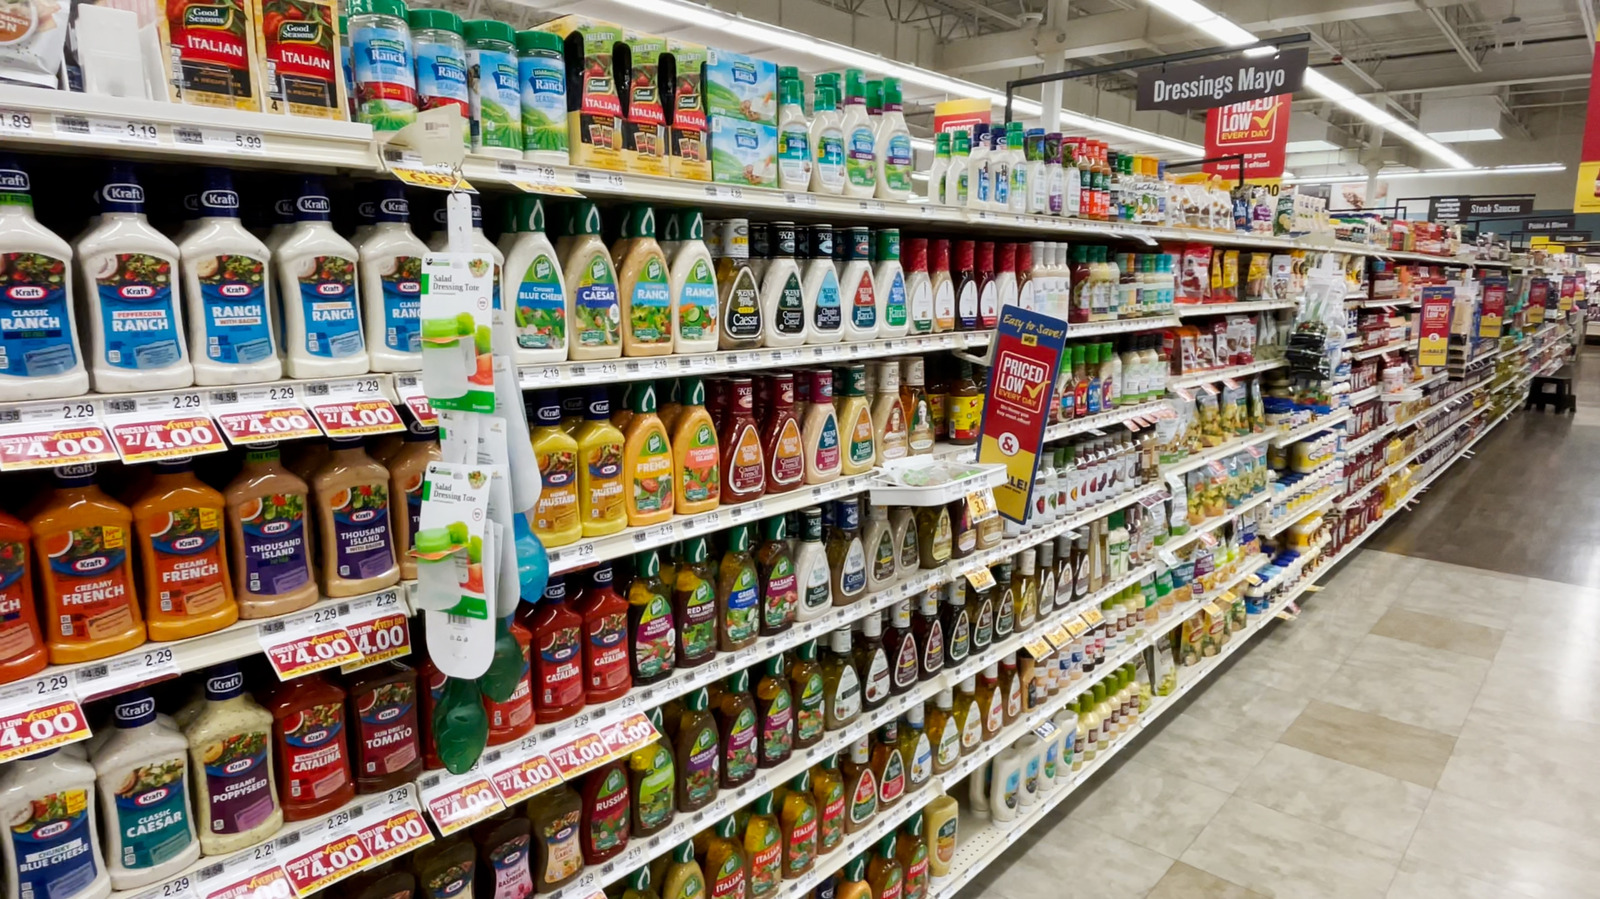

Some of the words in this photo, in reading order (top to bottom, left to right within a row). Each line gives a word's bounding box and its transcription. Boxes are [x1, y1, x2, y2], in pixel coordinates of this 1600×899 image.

[188, 14, 224, 24] Seasons
[193, 8, 218, 17] Good
[282, 30, 315, 39] Seasons
[286, 24, 309, 33] Good
[187, 35, 243, 57] ITALIAN
[281, 50, 330, 70] ITALIAN
[371, 50, 406, 66] Ranch
[438, 66, 466, 82] Ranch
[536, 79, 565, 93] Ranch
[1153, 75, 1233, 102] Dressings
[1238, 67, 1285, 93] Mayo
[585, 97, 620, 113] ITALIAN
[630, 107, 663, 122] ITALIAN
[1221, 113, 1252, 132] LOW
[127, 124, 157, 139] 3.19
[1221, 131, 1250, 140] EVERY
[1251, 129, 1269, 138] DAY
[235, 135, 261, 148] 5.99
[112, 187, 141, 200] Kraft
[209, 193, 236, 206] Kraft
[304, 199, 328, 210] Kraft
[1470, 204, 1492, 213] Steak
[433, 274, 452, 283] Salad
[15, 287, 40, 297] Kraft
[126, 286, 148, 297] Kraft
[225, 285, 246, 295] Kraft
[322, 284, 340, 293] Kraft
[432, 282, 463, 293] Dressing
[465, 284, 480, 292] Tote
[685, 286, 714, 298] RANCH
[519, 291, 539, 300] BLUE
[582, 291, 615, 301] CAESAR
[637, 289, 669, 300] RANCH
[12, 309, 49, 317] CLASSIC
[212, 305, 261, 318] RANCH
[312, 309, 355, 321] RANCH
[1, 317, 60, 330] RANCH
[112, 318, 169, 332] RANCH
[733, 314, 758, 326] Caesar
[1002, 314, 1025, 333] Easy
[1025, 320, 1036, 330] to
[1036, 324, 1064, 339] Save!
[543, 369, 560, 378] 2.19
[1003, 357, 1044, 384] PRICED
[357, 380, 379, 393] 2.29
[1000, 373, 1025, 394] LOW
[269, 387, 295, 400] 2.29
[998, 388, 1021, 401] EVERY
[172, 395, 200, 409] 2.29
[62, 404, 94, 419] 2.29
[637, 460, 670, 472] FRENCH
[435, 482, 452, 492] Salad
[433, 490, 462, 501] Dressing
[540, 495, 576, 508] MUSTARD
[355, 511, 371, 519] Kraft
[266, 523, 285, 532] Kraft
[340, 525, 386, 540] THOUSAND
[178, 539, 199, 548] Kraft
[251, 537, 301, 553] THOUSAND
[350, 534, 380, 546] ISLAND
[261, 547, 294, 560] ISLAND
[79, 559, 103, 568] Kraft
[173, 558, 208, 570] CREAMY
[162, 563, 219, 583] FRENCH
[75, 580, 113, 593] CREAMY
[62, 584, 125, 606] FRENCH
[376, 593, 397, 607] 2.29
[314, 608, 337, 623] 2.29
[687, 606, 701, 616] RED
[144, 649, 173, 667] 2.29
[594, 650, 626, 666] CATALINA
[546, 666, 580, 683] CATALINA
[37, 675, 68, 694] 2.29
[213, 675, 240, 690] Kraft
[121, 702, 150, 718] Kraft
[380, 709, 397, 719] Kraft
[307, 731, 325, 742] Kraft
[366, 728, 412, 749] TOMATO
[229, 760, 248, 771] Kraft
[291, 751, 341, 772] CATALINA
[213, 778, 267, 803] POPPYSEED
[225, 777, 256, 793] CREAMY
[142, 791, 163, 802] Kraft
[388, 788, 408, 804] 2.29
[596, 788, 628, 812] RUSSIAN
[138, 808, 171, 825] CLASSIC
[327, 813, 349, 830] 2.29
[40, 823, 63, 836] Kraft
[126, 811, 183, 838] CAESAR
[793, 821, 817, 839] ITALIAN
[20, 858, 49, 872] BLUE
[51, 843, 89, 865] CHEESE
[756, 846, 780, 864] ITALIAN
[163, 877, 190, 897] 2.29
[715, 872, 743, 892] ITALIAN
